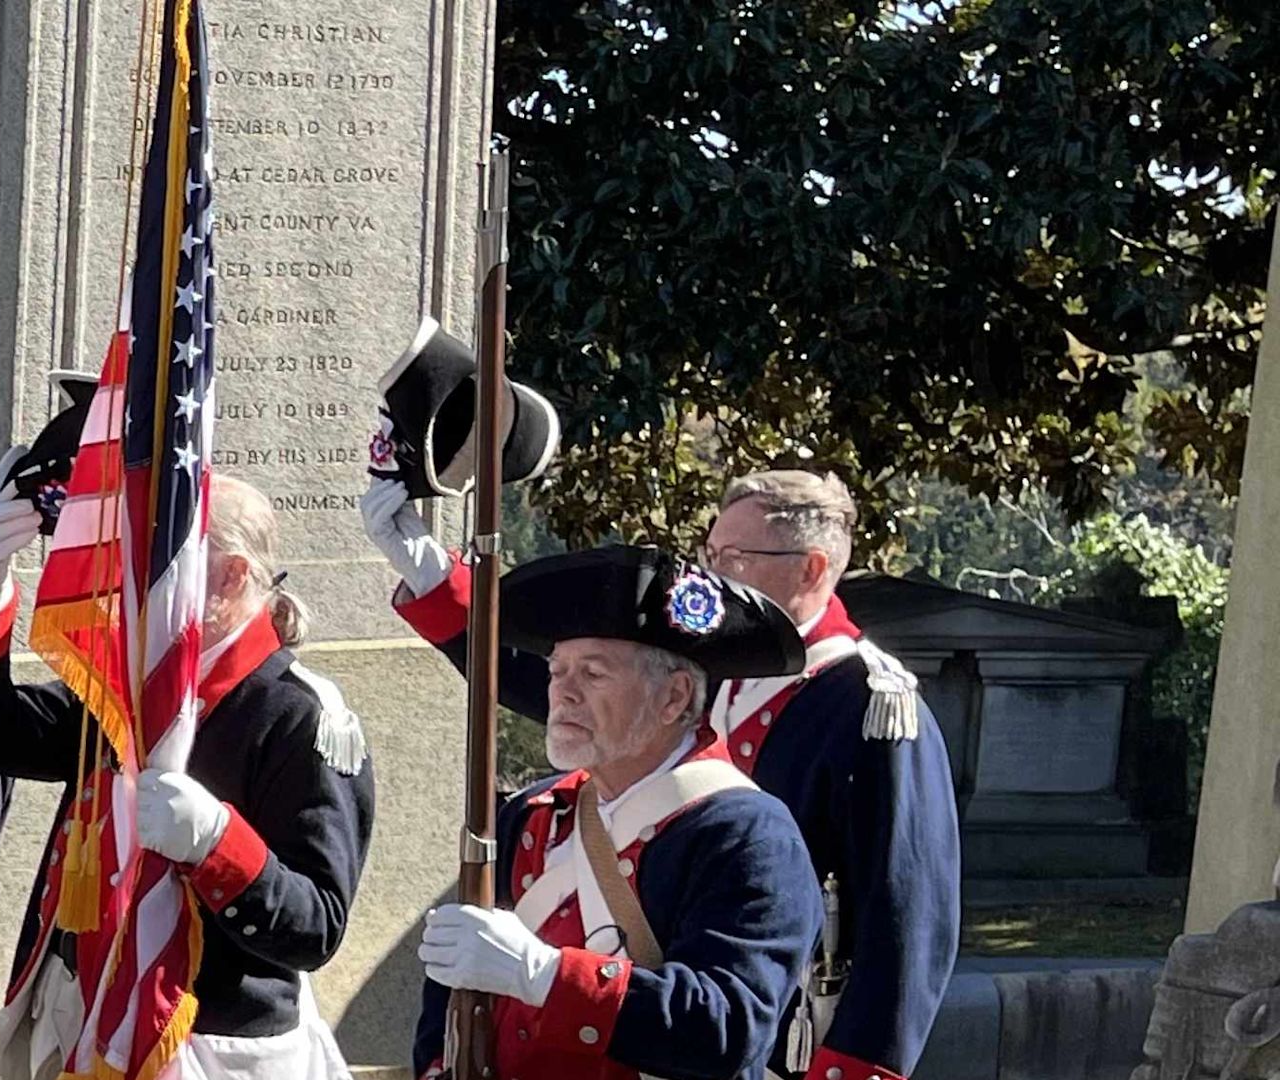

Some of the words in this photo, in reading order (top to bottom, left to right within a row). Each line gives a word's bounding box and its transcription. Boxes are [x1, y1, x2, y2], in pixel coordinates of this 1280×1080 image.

[208, 22, 244, 40] TIA
[258, 23, 384, 43] CHRISTIAN
[214, 70, 315, 88] OVEMBER
[212, 120, 288, 137] TEMBER
[261, 168, 326, 183] CEDAR
[333, 168, 399, 183] GROVE
[260, 214, 340, 231] COUNTY
[347, 215, 376, 231] VA
[264, 262, 354, 278] SECOND
[236, 309, 339, 326] GARDINER
[216, 356, 269, 372] JULY
[275, 356, 298, 372] 23
[215, 404, 268, 420] JULY
[277, 404, 297, 418] 10
[247, 450, 272, 466] BY
[278, 448, 306, 465] HIS
[316, 448, 360, 464] SIDE
[272, 495, 360, 512] ONUMEN
